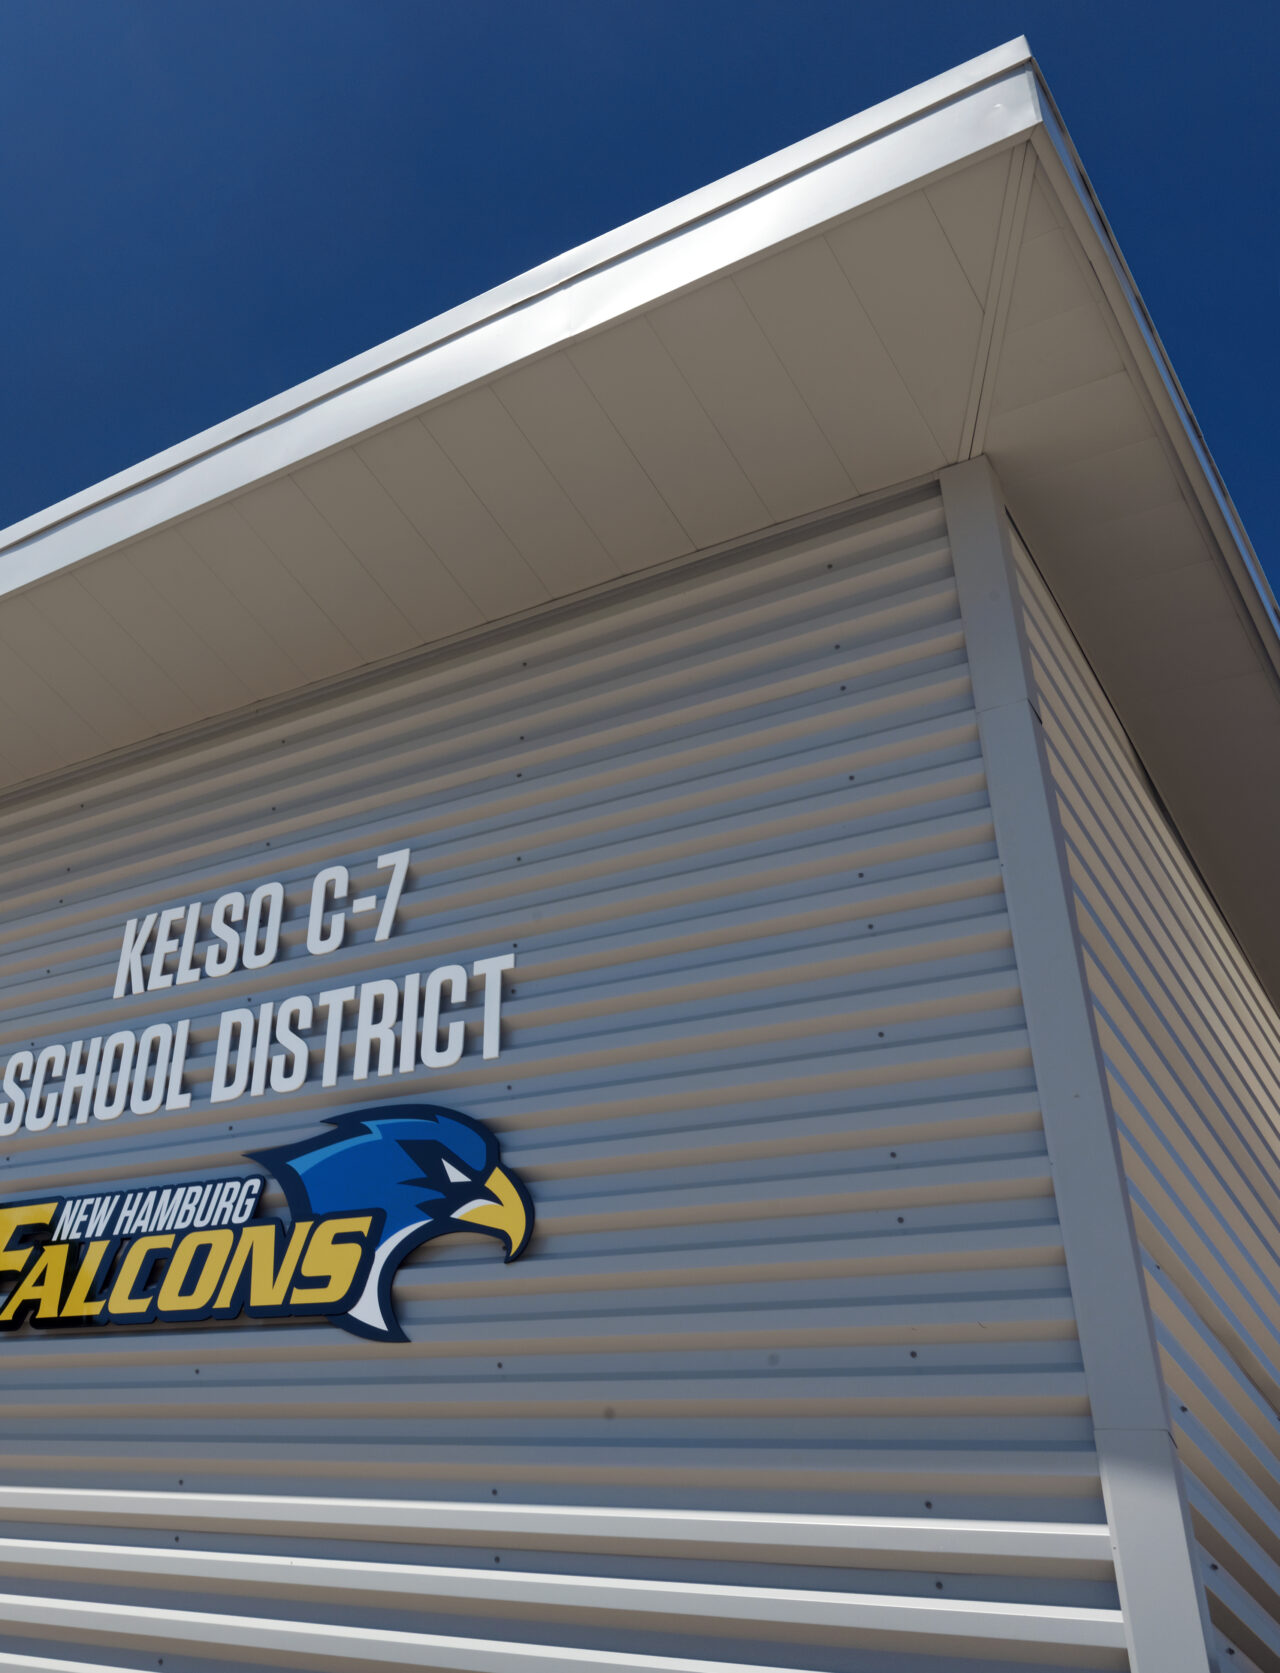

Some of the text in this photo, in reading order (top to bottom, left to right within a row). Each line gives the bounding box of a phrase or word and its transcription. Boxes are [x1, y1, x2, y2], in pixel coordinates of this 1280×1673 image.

[113, 848, 411, 999] KELSO C-7
[210, 953, 516, 1103] DISTRICT
[52, 1178, 261, 1242] NEW HAMBURG
